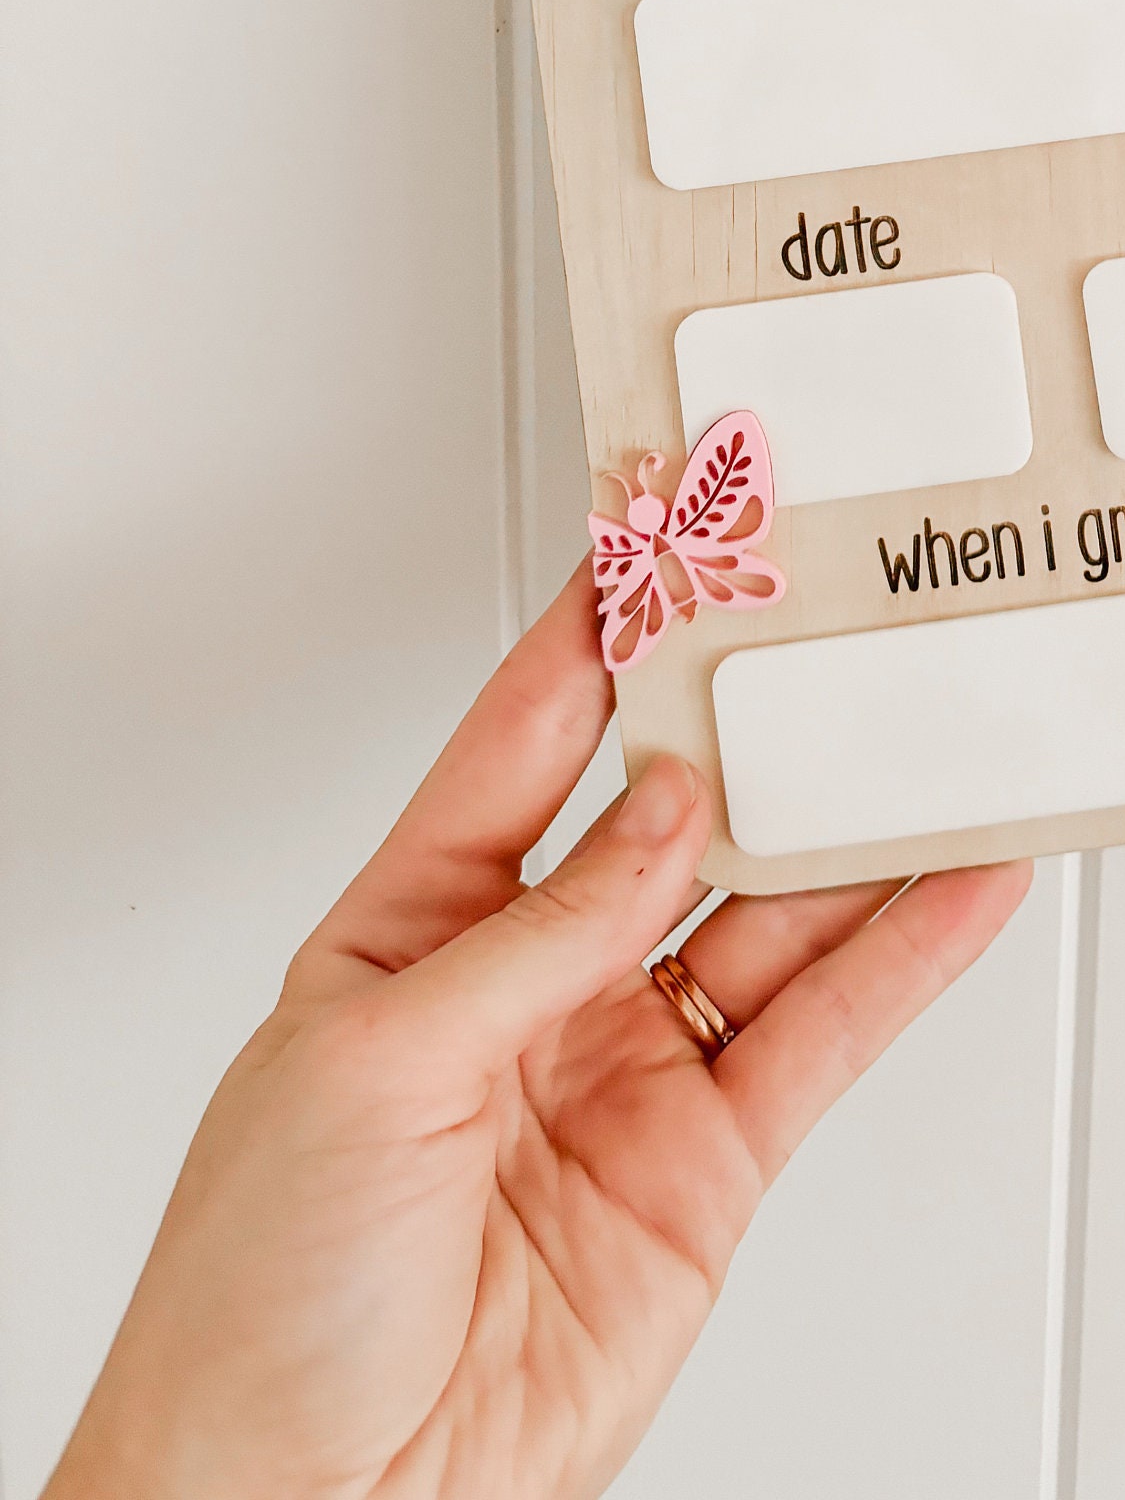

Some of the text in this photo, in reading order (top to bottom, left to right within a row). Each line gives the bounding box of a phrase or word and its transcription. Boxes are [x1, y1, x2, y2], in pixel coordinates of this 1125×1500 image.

[781, 205, 901, 280] date
[877, 516, 1026, 594] when
[1040, 504, 1057, 572] i
